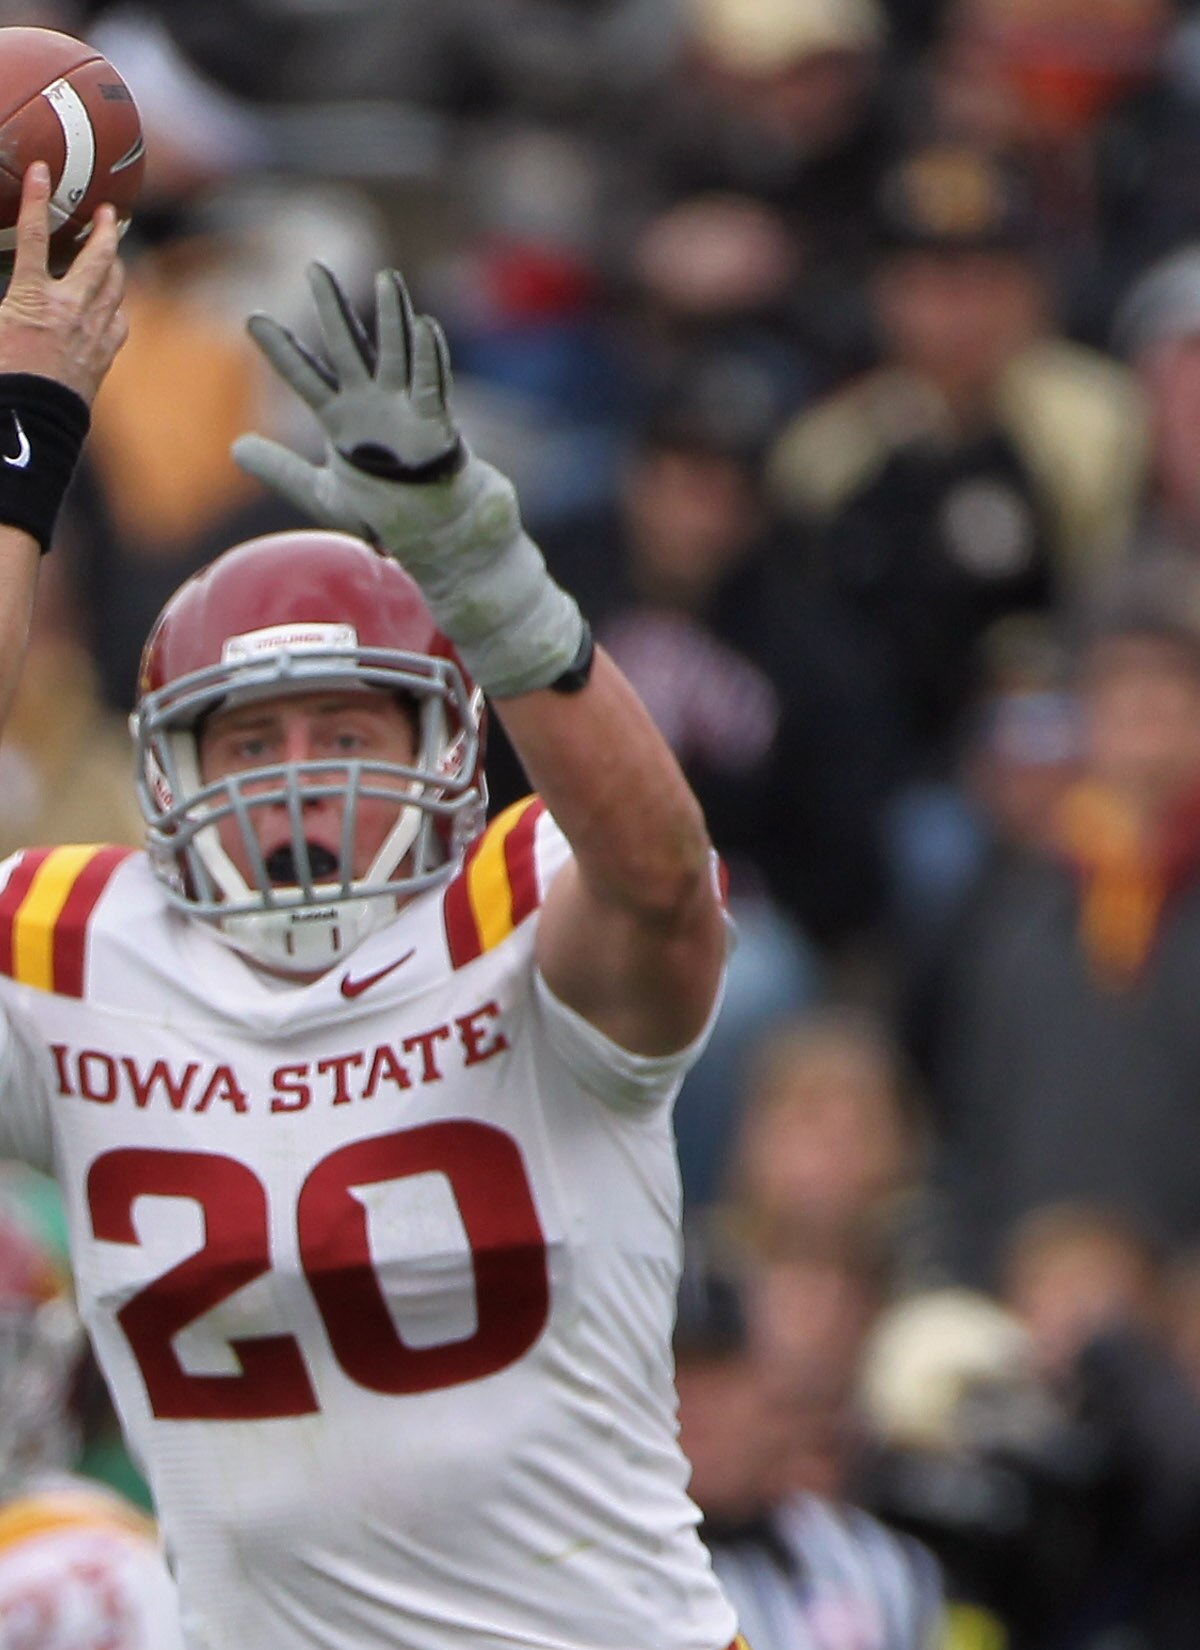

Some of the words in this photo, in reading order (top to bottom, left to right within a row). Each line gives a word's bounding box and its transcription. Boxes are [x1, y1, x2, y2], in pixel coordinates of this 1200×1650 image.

[49, 1044, 248, 1114] IOWA
[270, 1000, 509, 1114] STATE
[86, 1117, 550, 1421] 20
